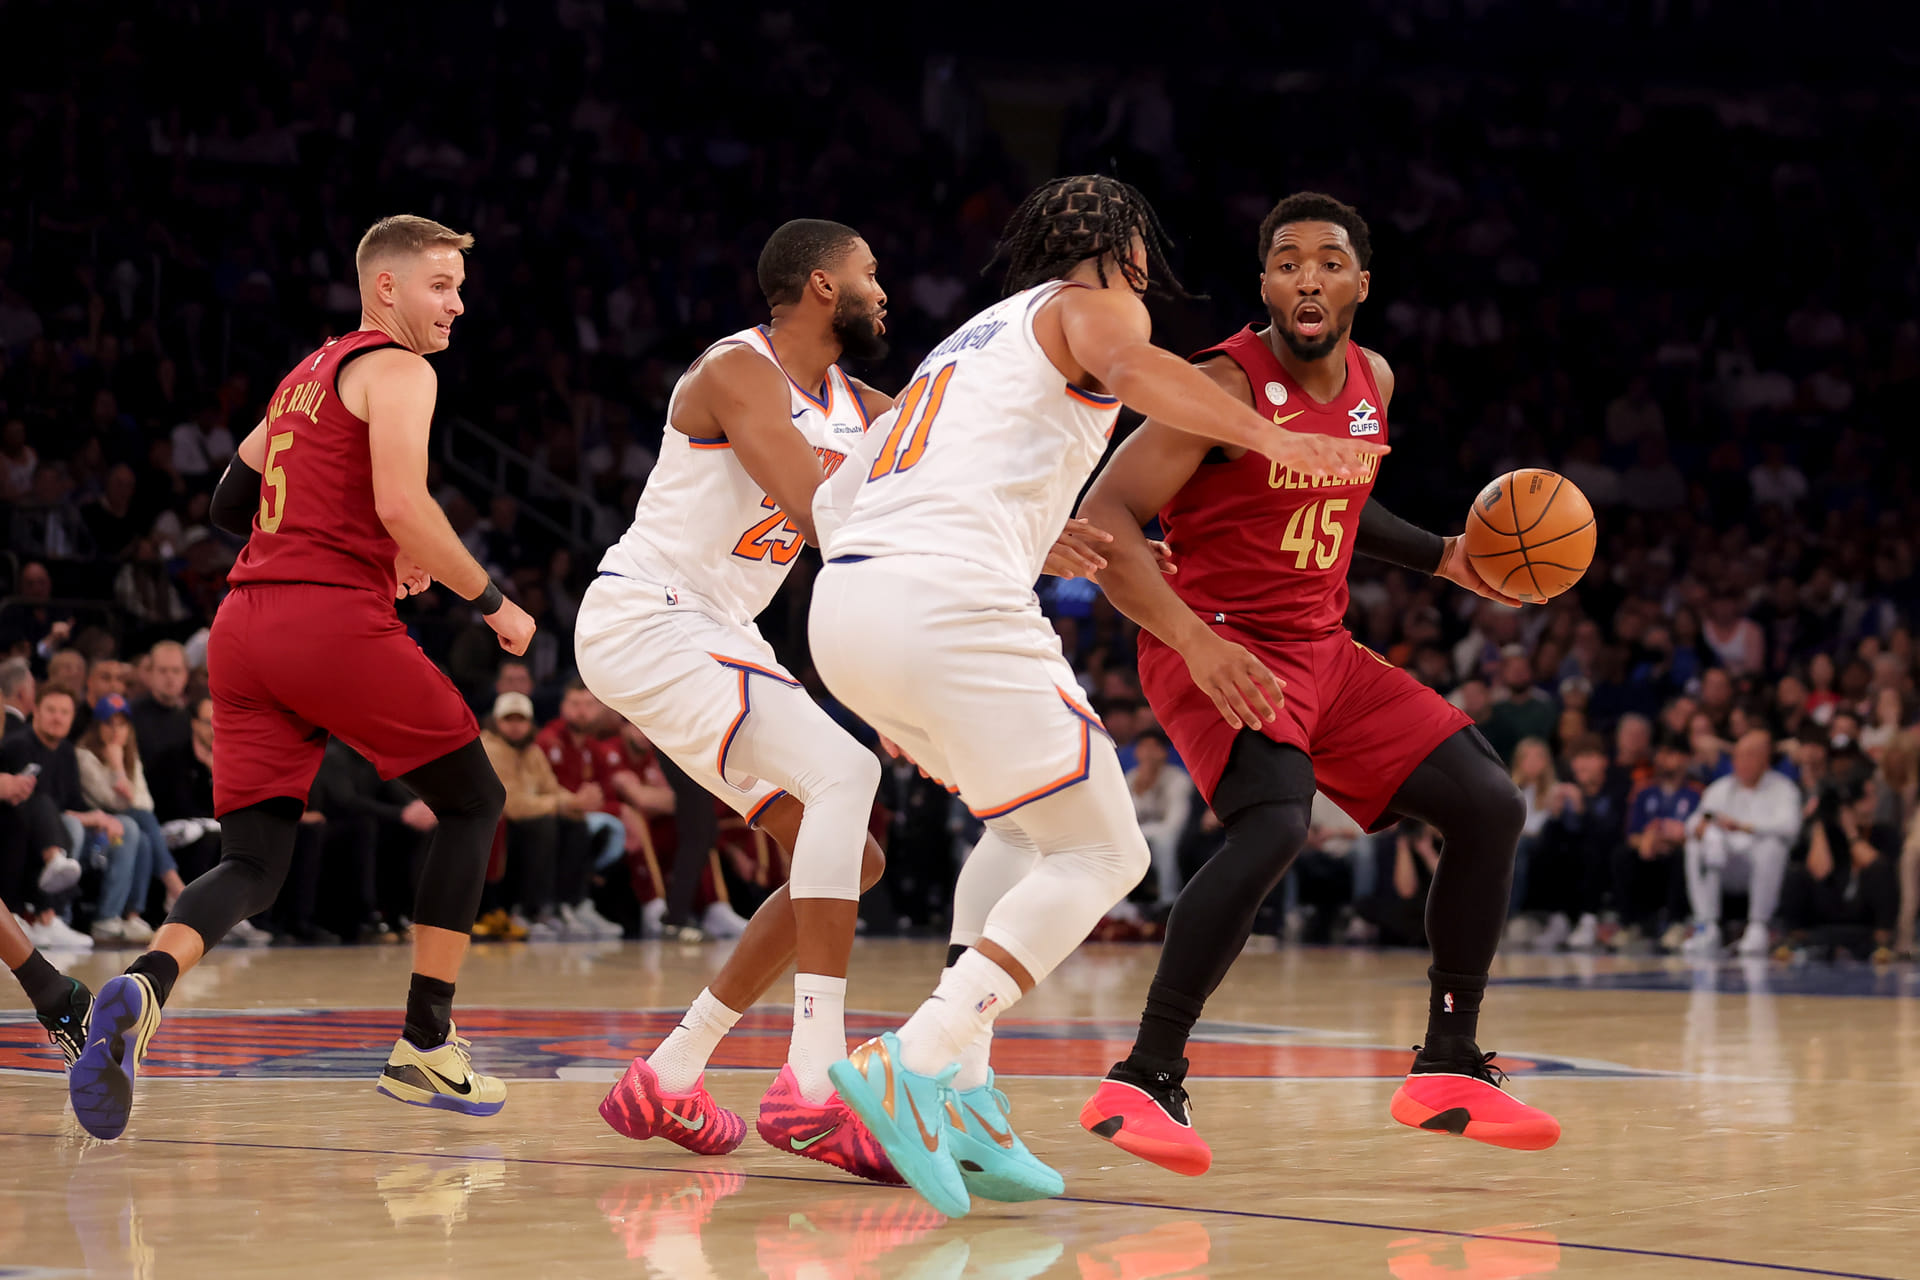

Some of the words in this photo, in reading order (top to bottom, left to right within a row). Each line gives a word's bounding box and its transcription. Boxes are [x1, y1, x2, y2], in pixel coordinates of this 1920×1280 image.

[867, 360, 957, 484] 11
[1350, 422, 1378, 433] CLIFFS
[259, 430, 293, 534] 5
[1268, 453, 1378, 489] CLEND
[731, 495, 804, 566] 25
[1280, 499, 1349, 569] 45
